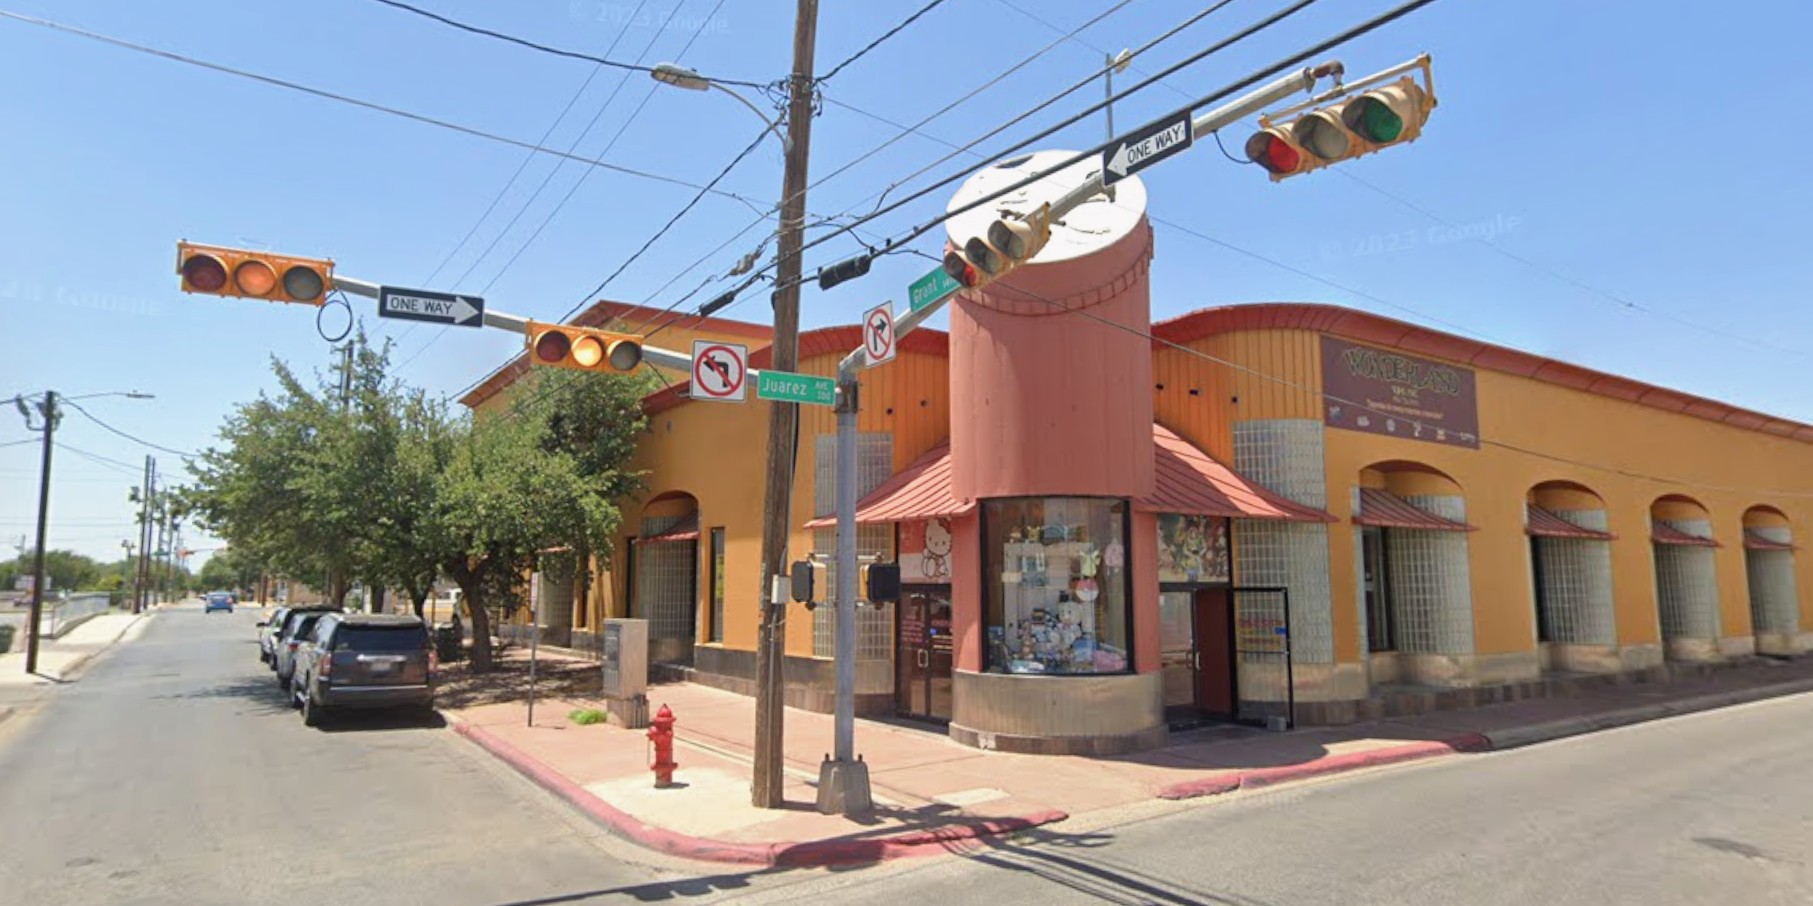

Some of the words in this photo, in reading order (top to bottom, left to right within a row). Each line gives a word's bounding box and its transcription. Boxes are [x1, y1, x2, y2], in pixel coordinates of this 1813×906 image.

[1127, 139, 1152, 163] ONE
[1154, 124, 1181, 151] WAY
[912, 276, 937, 304] Grant
[390, 296, 419, 312] ONE
[424, 301, 453, 315] WAY
[1342, 347, 1461, 397] WONDERLAND
[762, 378, 807, 396] Juarez
